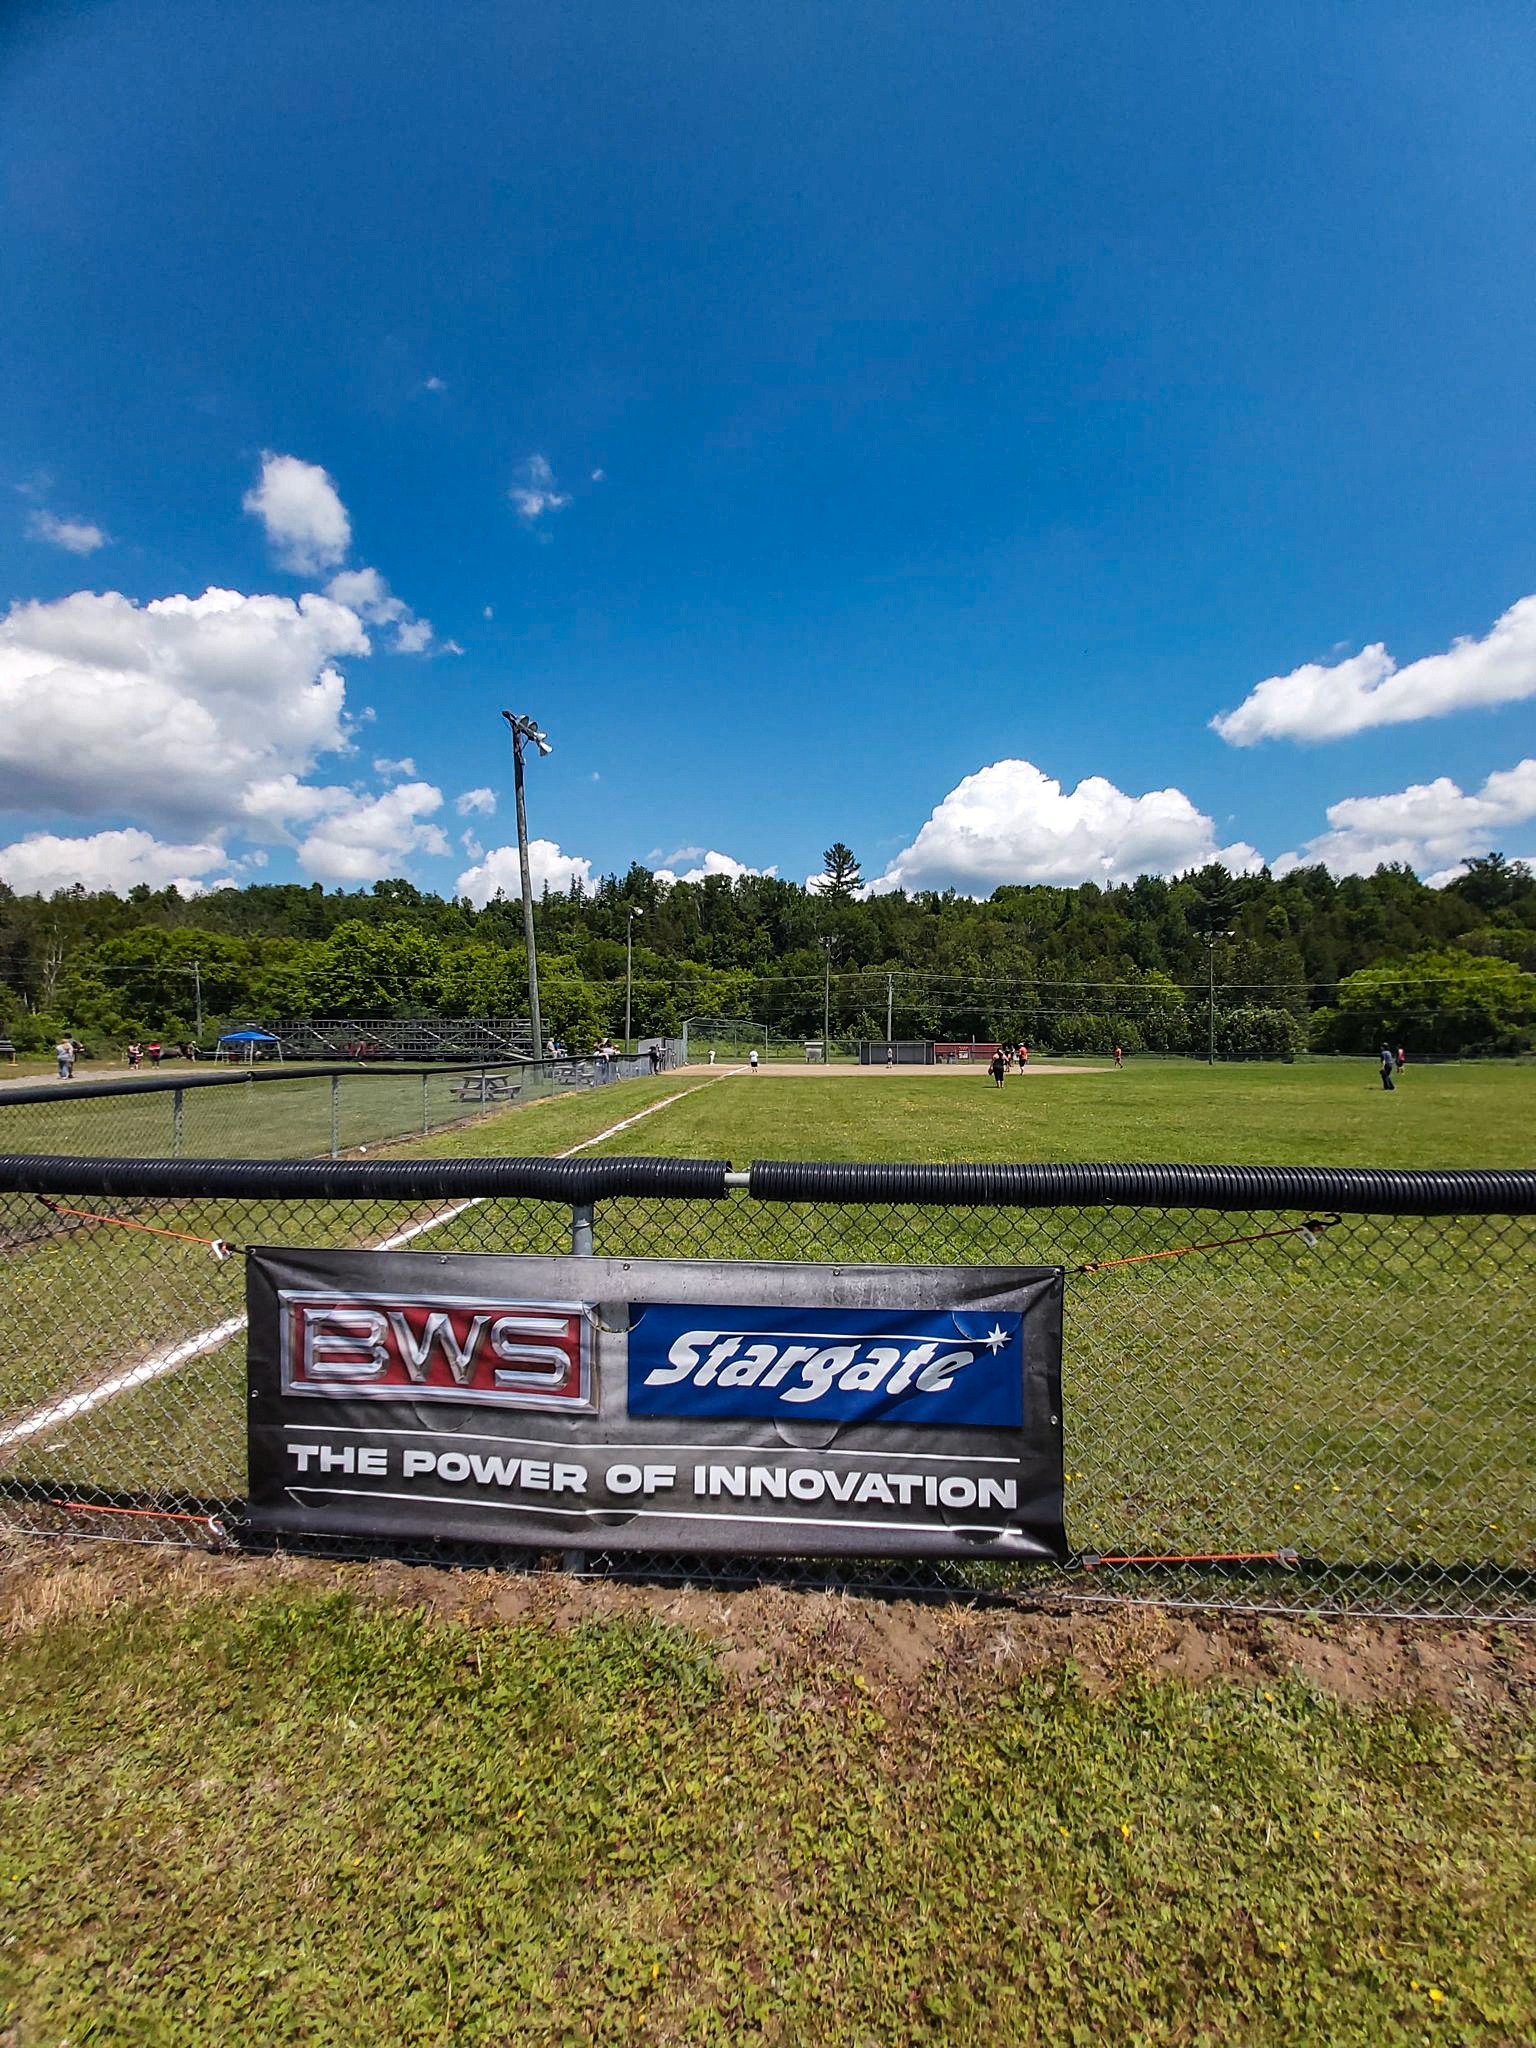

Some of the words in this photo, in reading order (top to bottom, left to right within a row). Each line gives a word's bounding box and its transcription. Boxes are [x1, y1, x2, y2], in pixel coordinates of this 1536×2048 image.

[303, 1308, 572, 1392] BWS
[643, 1330, 975, 1403] Stargate
[287, 1443, 388, 1476] THE
[402, 1449, 588, 1494] POWER
[605, 1464, 677, 1495] OF
[693, 1464, 1018, 1509] INNOVATION
